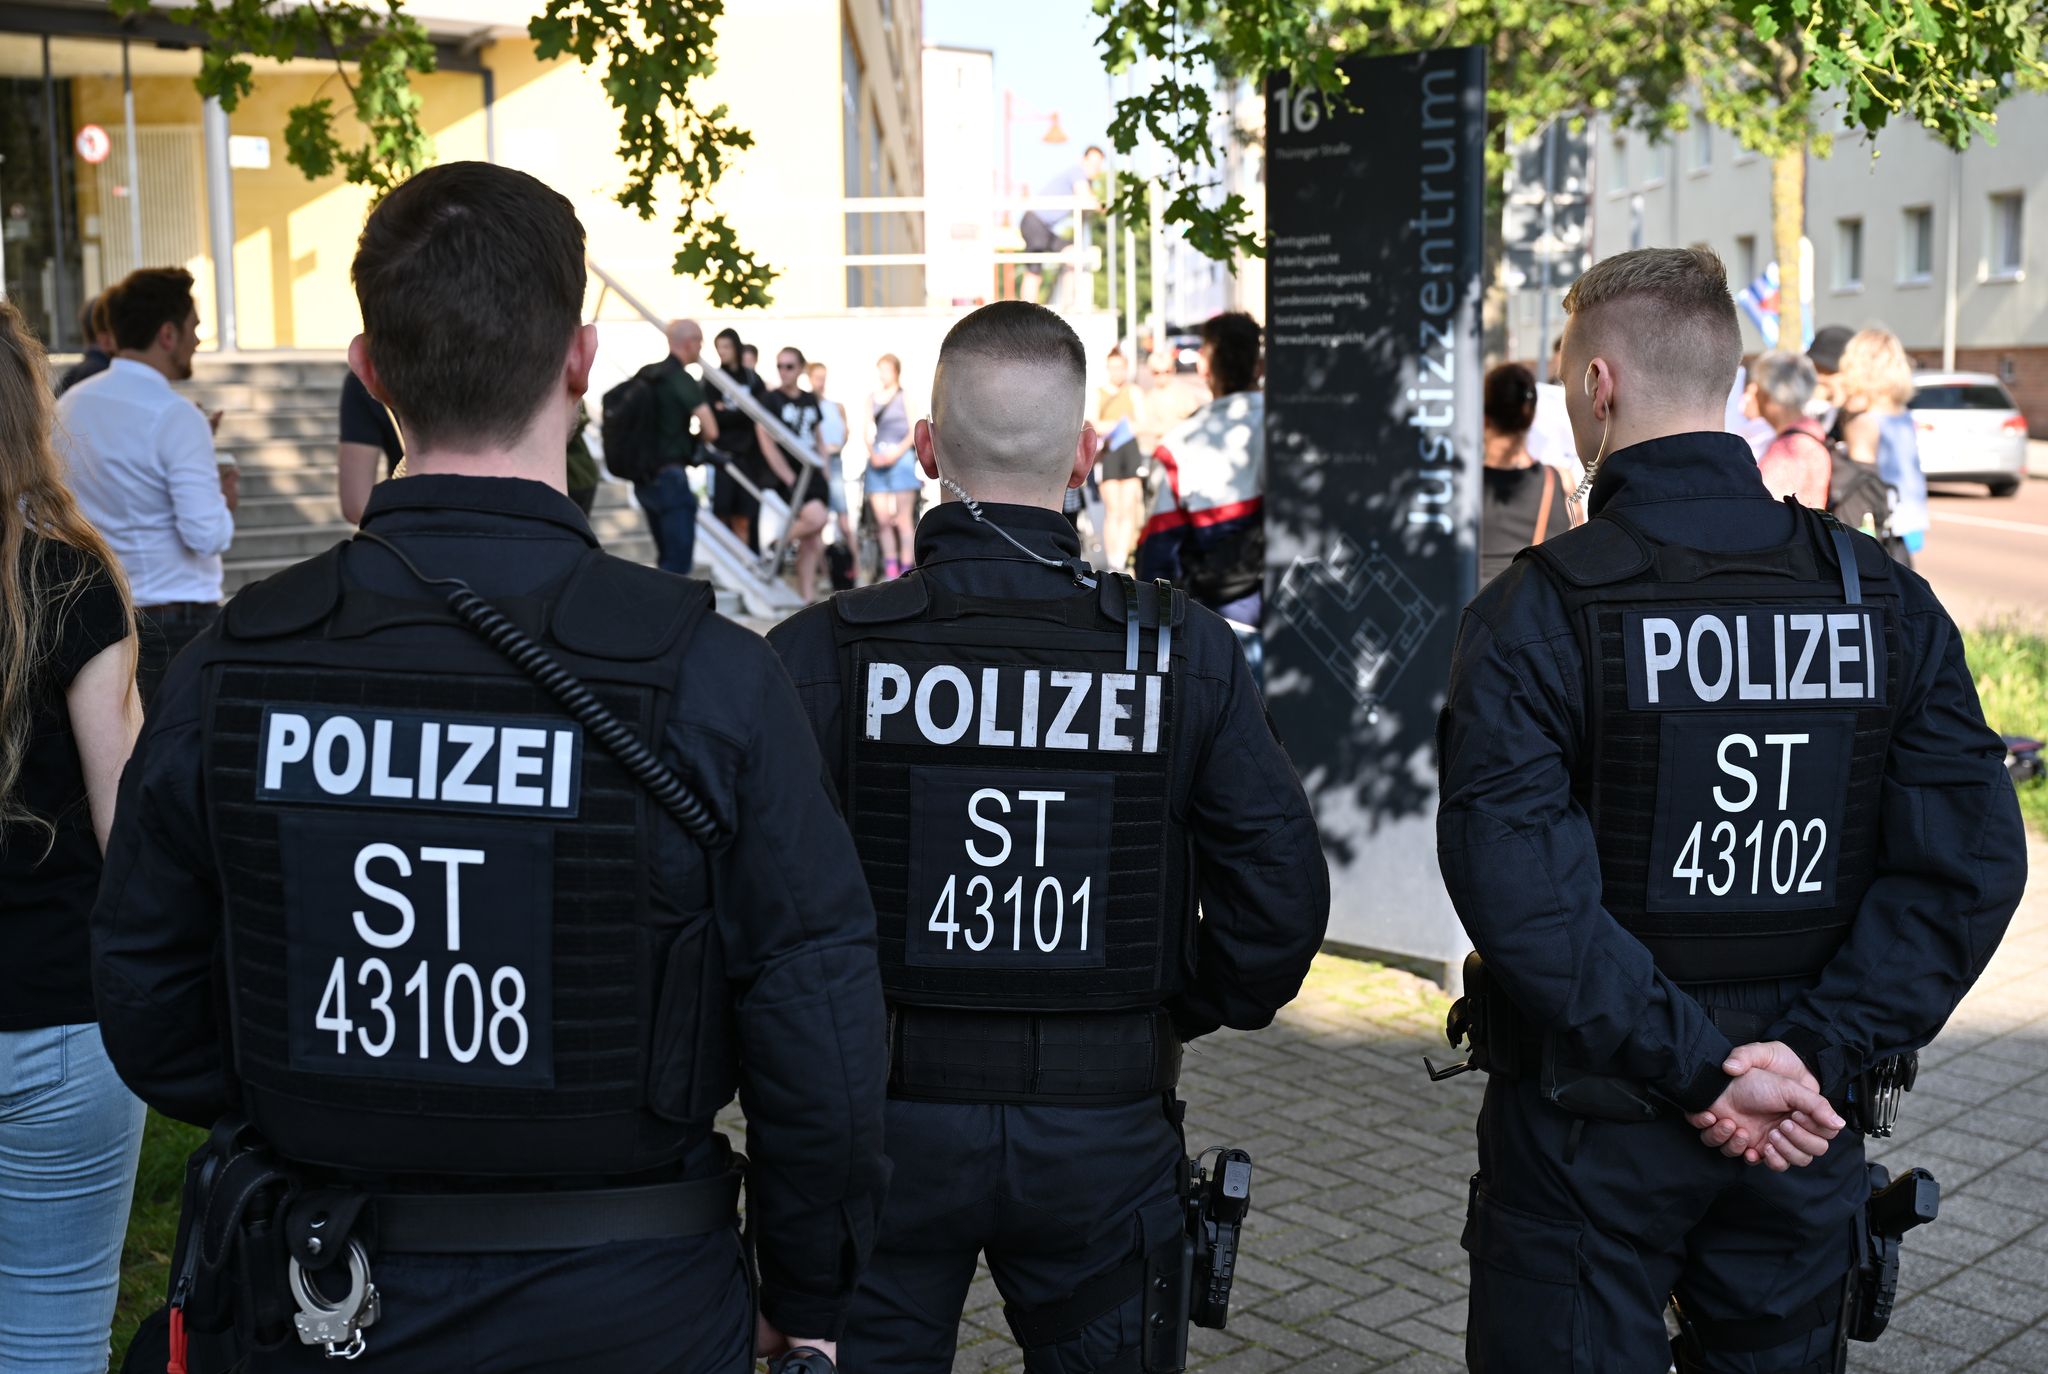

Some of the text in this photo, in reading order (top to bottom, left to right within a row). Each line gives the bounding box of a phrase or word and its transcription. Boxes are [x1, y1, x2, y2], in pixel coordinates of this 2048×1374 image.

[1273, 87, 1320, 134] 16
[1273, 252, 1340, 268] Arbeitsgericht
[1273, 271, 1371, 287] Landesarbeitsgericht
[1273, 292, 1366, 308] Landessozialgericht
[1273, 312, 1334, 328] Sozialgericht
[1273, 332, 1365, 348] Verwaltungsgericht
[1642, 613, 1876, 703] POLIZEI
[866, 662, 1162, 753] POLIZEI
[264, 712, 574, 808] POLIZEI
[1712, 733, 1809, 813] ST
[965, 788, 1065, 867] ST
[1672, 818, 1827, 897] 43102
[352, 842, 485, 951] ST
[928, 874, 1091, 952] 43101
[315, 956, 529, 1066] 43108
